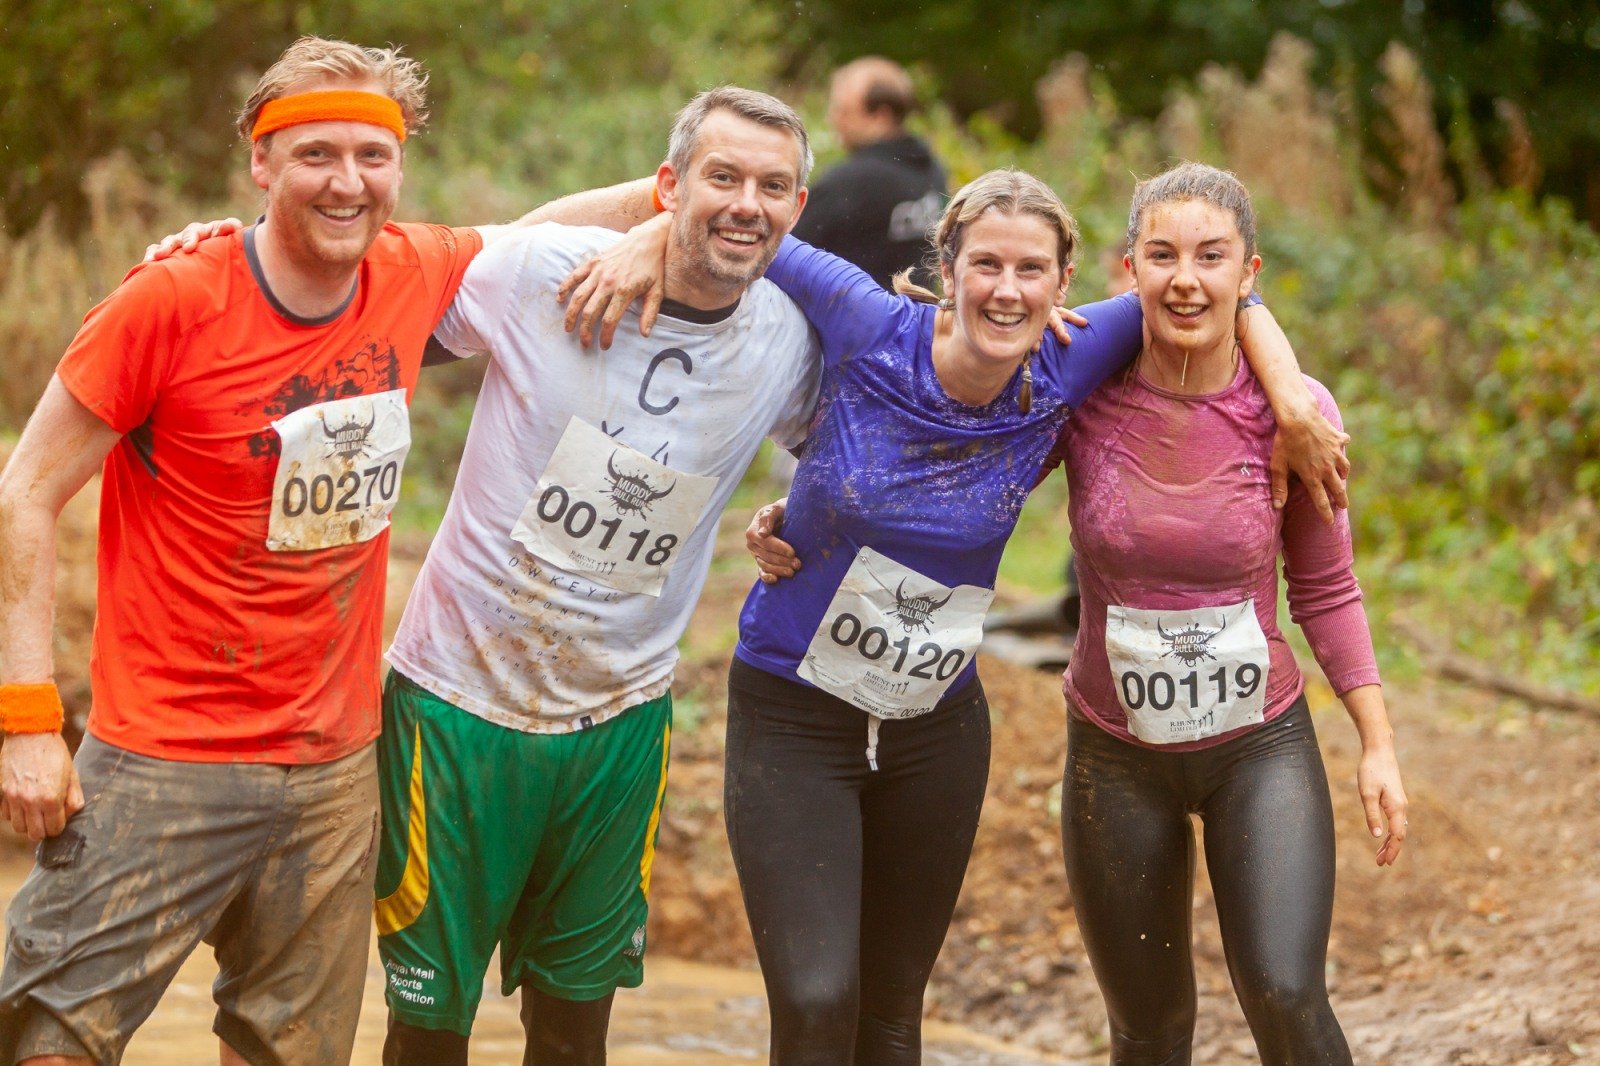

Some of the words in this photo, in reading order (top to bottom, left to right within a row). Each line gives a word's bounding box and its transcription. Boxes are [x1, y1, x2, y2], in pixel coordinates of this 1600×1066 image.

[638, 347, 693, 415] C
[336, 428, 365, 442] MUDDY
[282, 461, 397, 517] 00270
[613, 488, 630, 502] BULL
[630, 497, 647, 508] RUN
[617, 478, 652, 500] MUDDY
[537, 485, 678, 566] 00118
[899, 607, 913, 619] BULL
[914, 612, 928, 621] RUN
[901, 599, 932, 615] MUDDY
[830, 613, 966, 681] 00120
[1174, 644, 1193, 653] BULL
[1194, 643, 1208, 652] RUN
[1175, 635, 1209, 644] MUDDY
[1121, 662, 1262, 711] 00119
[853, 696, 879, 713] BAGGAGE
[879, 707, 895, 717] LABEL
[901, 707, 930, 717] 00120
[390, 973, 422, 990] Sports
[410, 966, 435, 980] Mail
